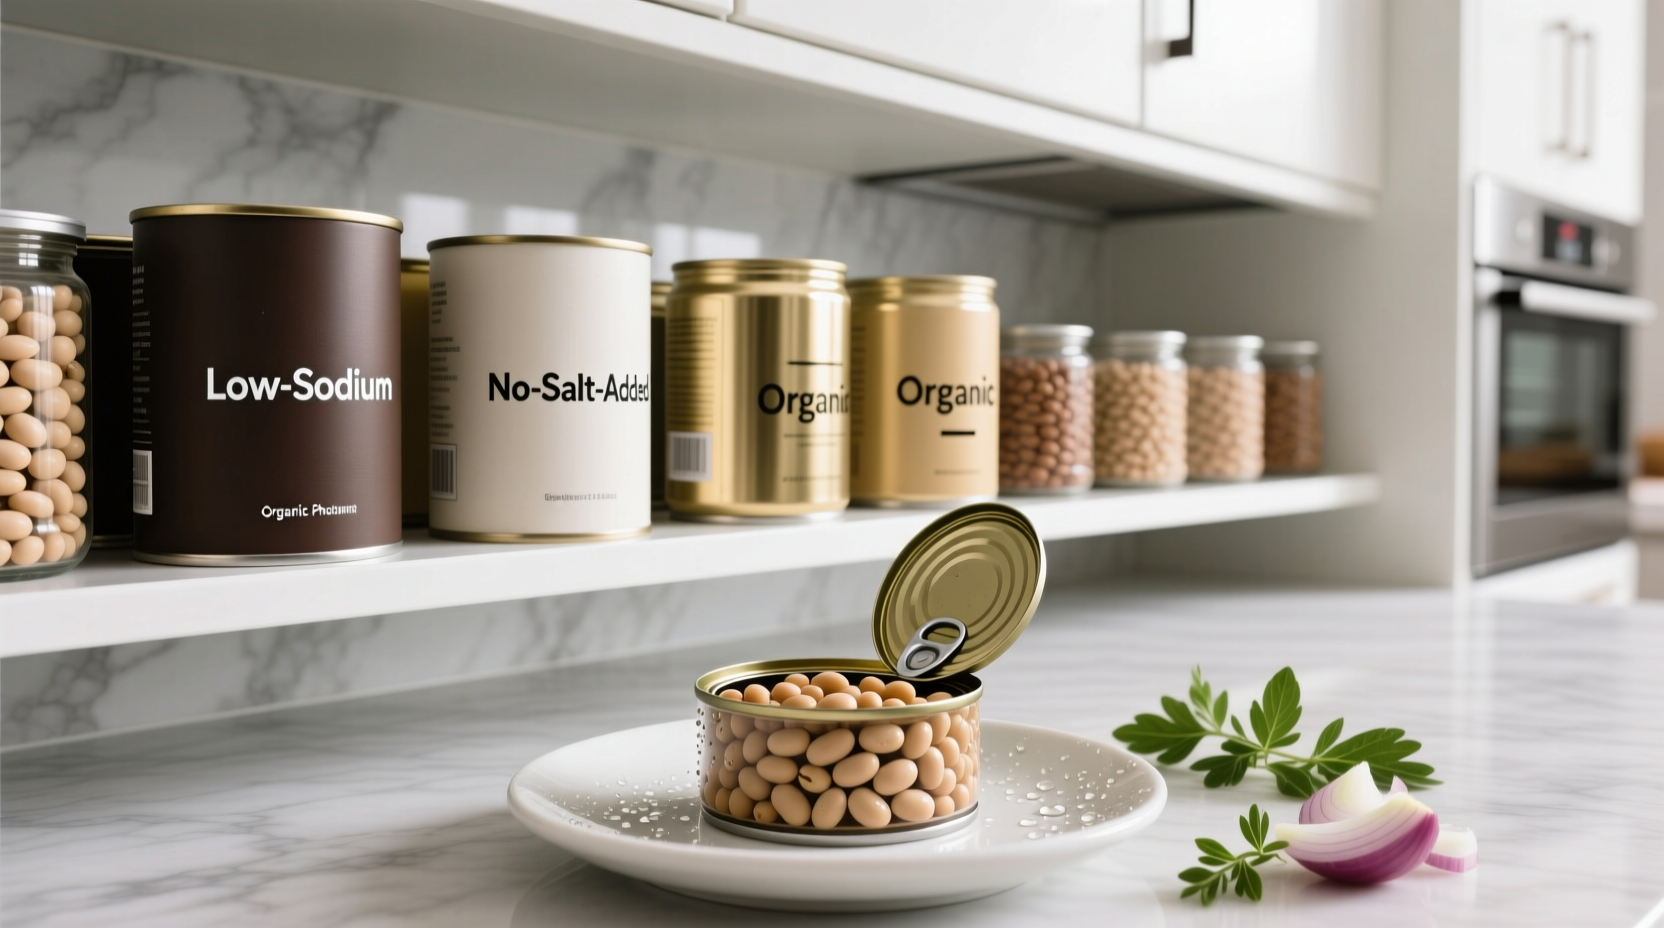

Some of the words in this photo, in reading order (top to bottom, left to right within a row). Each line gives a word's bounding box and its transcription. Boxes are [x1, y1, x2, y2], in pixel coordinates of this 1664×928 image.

[206, 367, 393, 402] Low-Sodium
[488, 371, 650, 403] No-Salt-Added
[896, 374, 995, 416] Organic
[261, 503, 309, 521] Organic
